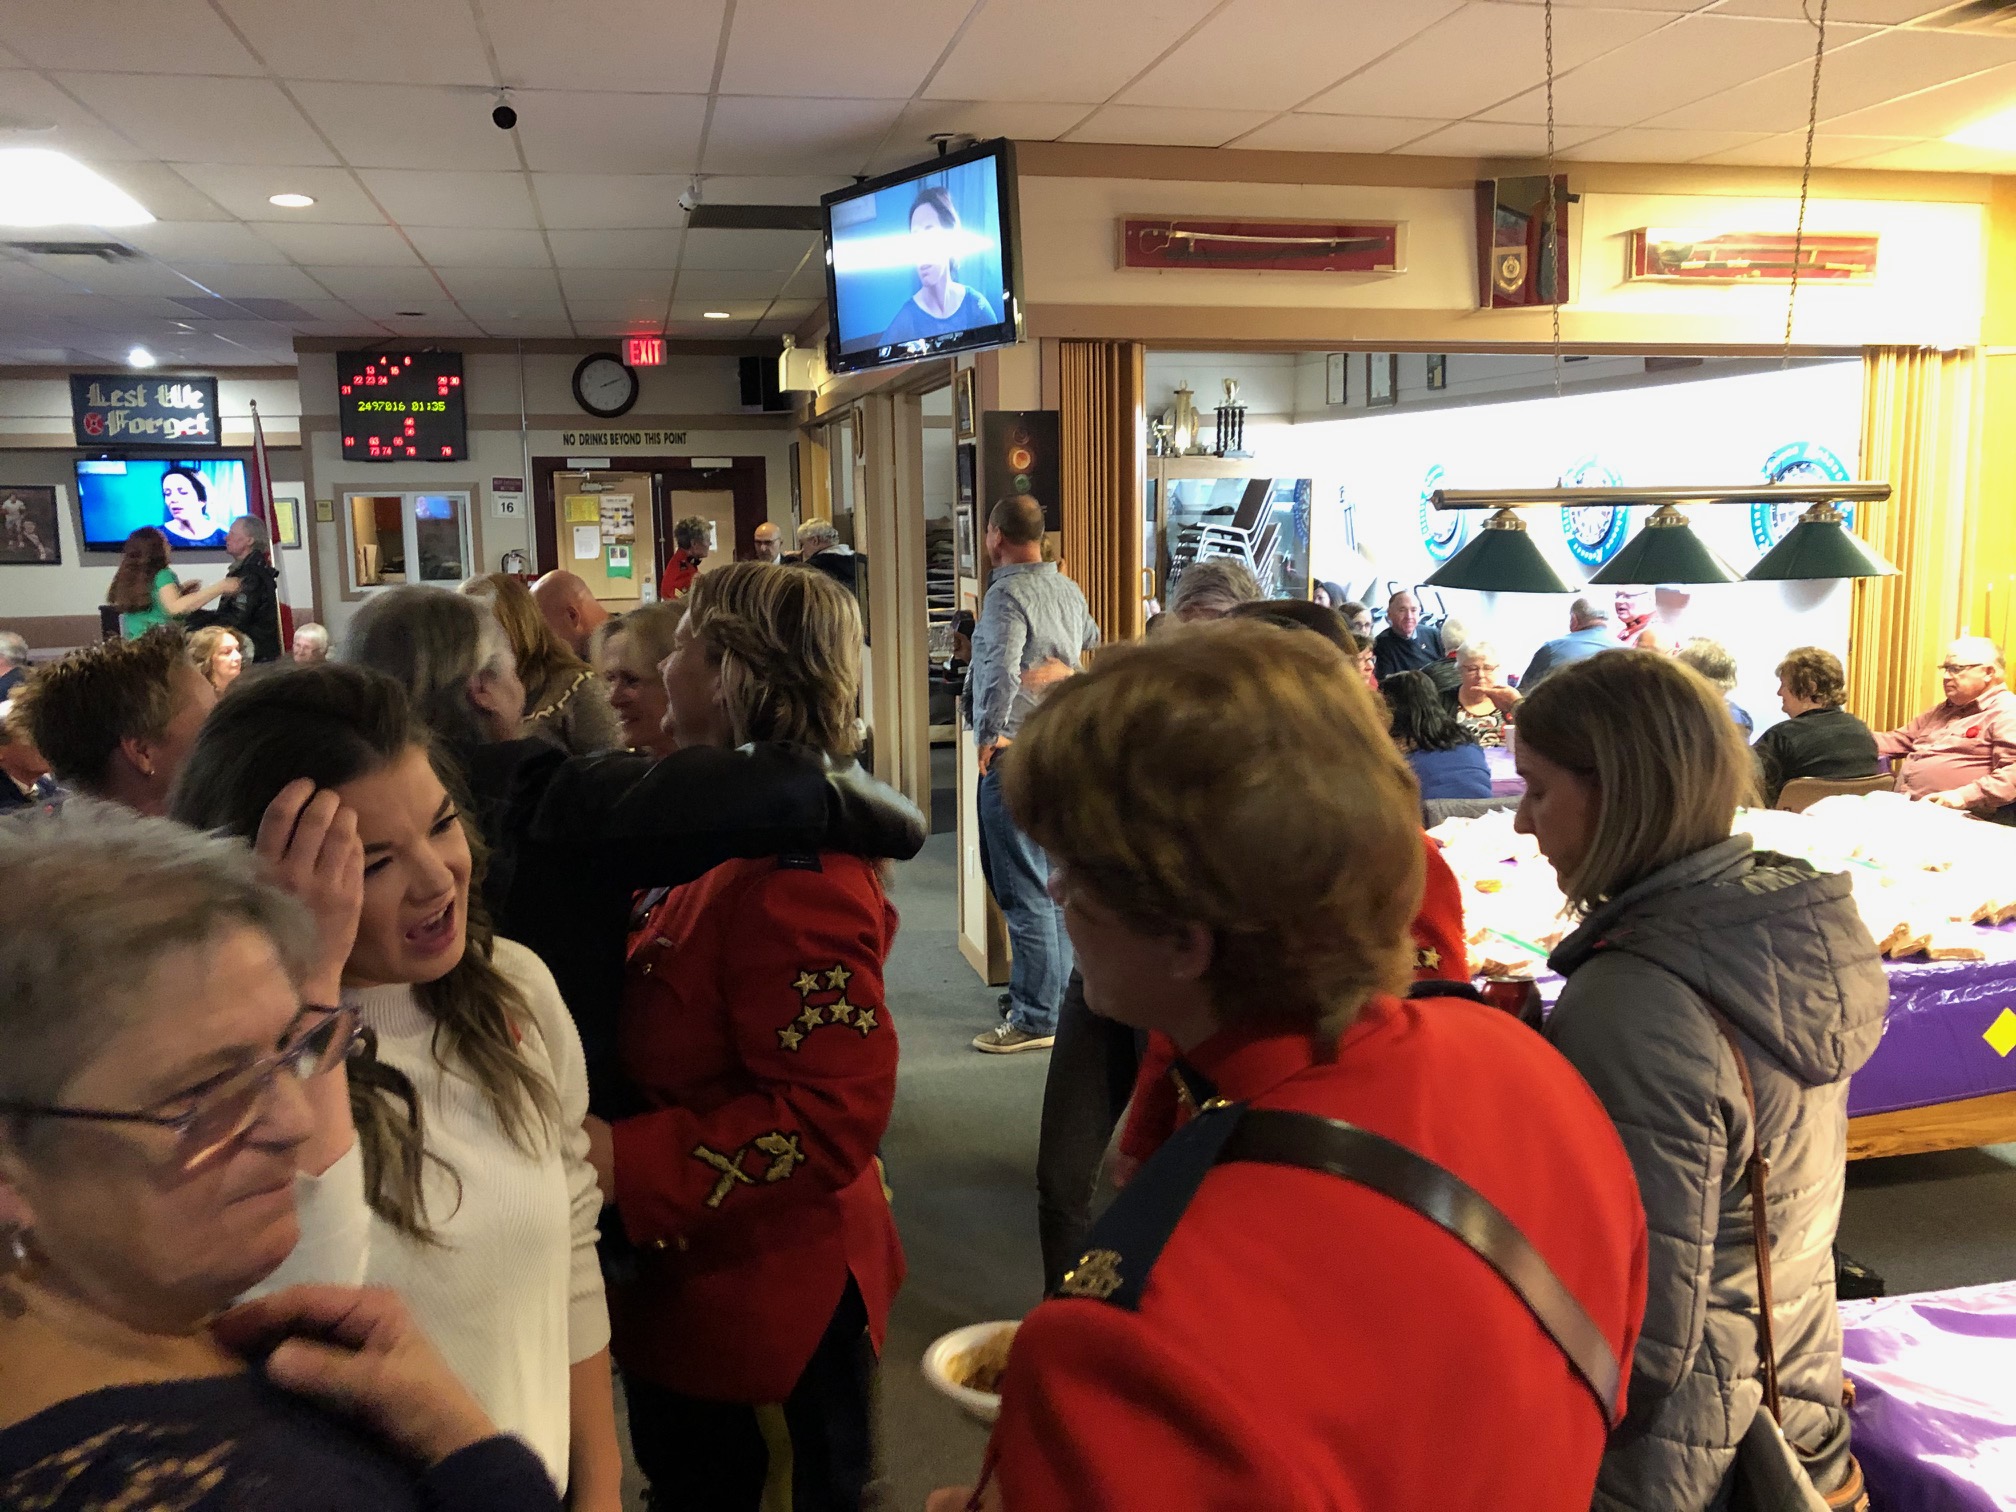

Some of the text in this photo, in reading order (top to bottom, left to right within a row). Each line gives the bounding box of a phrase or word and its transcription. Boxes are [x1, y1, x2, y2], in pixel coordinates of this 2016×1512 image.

[629, 340, 661, 365] EXIT
[380, 356, 411, 366] 4 6
[366, 366, 375, 375] 13
[353, 375, 363, 385] 22
[365, 375, 376, 385] 23
[378, 375, 388, 385] 24
[341, 385, 352, 395] 31
[86, 383, 205, 409] Lest We
[357, 401, 446, 412] 2497016 01:35
[105, 409, 210, 439] Forget
[562, 432, 687, 445] NO DRINKS BEYOND THIS POINT
[369, 446, 380, 456] 73
[501, 502, 514, 513] 16
